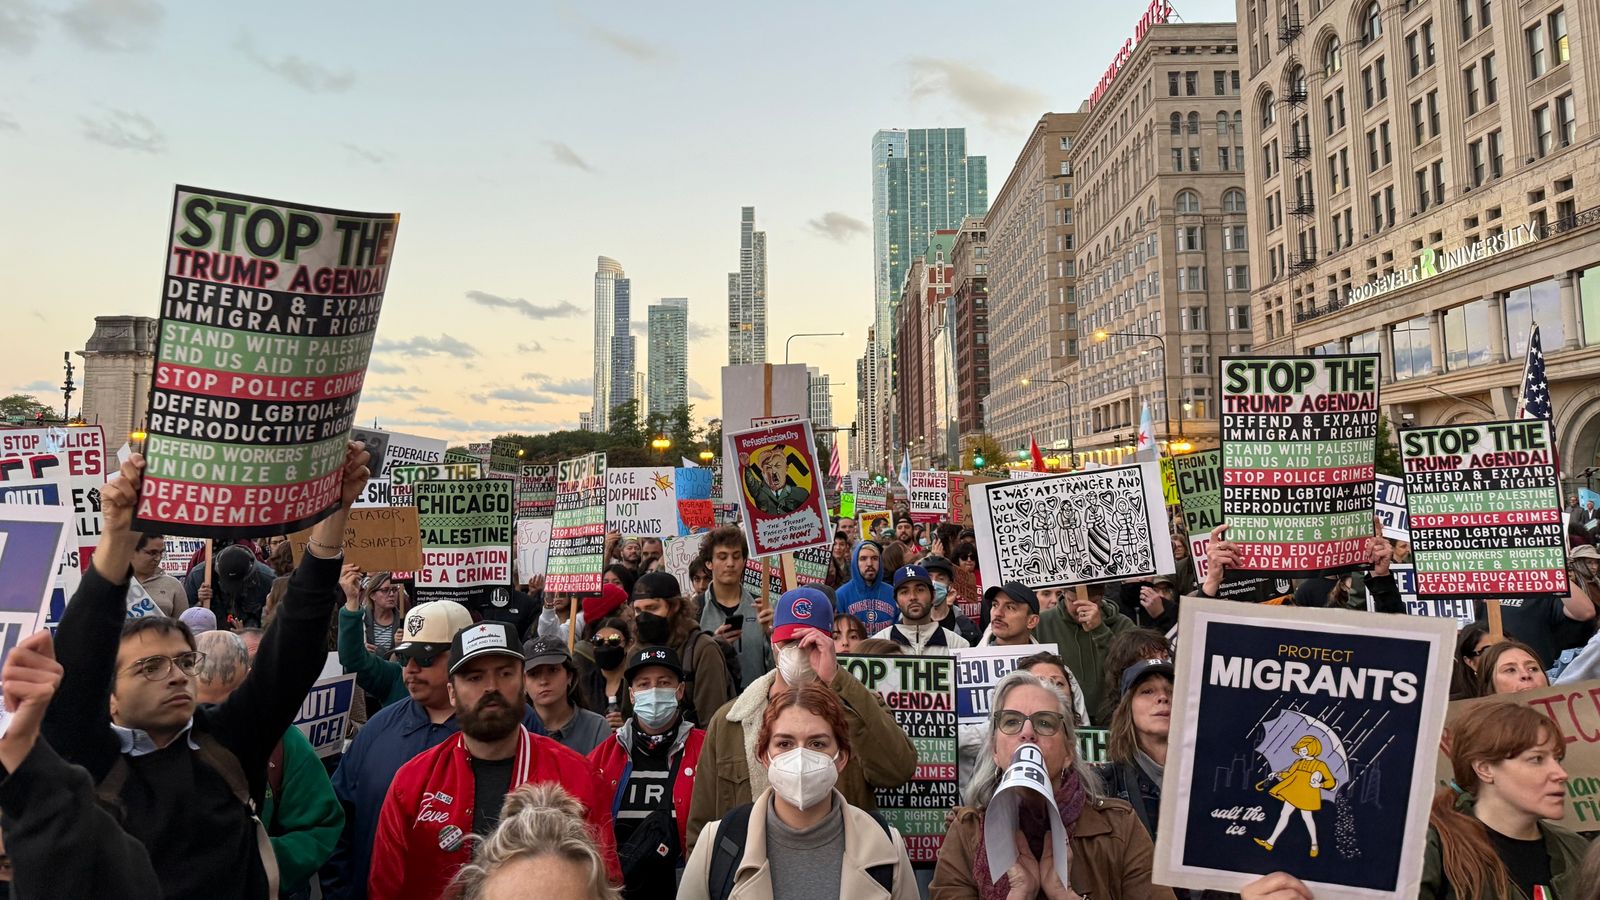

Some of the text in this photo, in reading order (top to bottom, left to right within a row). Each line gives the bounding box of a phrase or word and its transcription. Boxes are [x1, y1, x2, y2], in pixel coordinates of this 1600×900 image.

[177, 196, 394, 266] STOP THE
[1347, 265, 1419, 304] ROOSEVELT
[1439, 220, 1539, 270] UNIVERSITY
[174, 247, 385, 295] TRUMP AGENDA!
[168, 280, 382, 316] DEFEND & EXPAND
[165, 300, 378, 335] IMMIGRANT RIGHTS
[164, 324, 300, 355] STAND WITH
[162, 344, 326, 374] END US AID TO
[157, 367, 315, 397] STOP POLICE
[1225, 360, 1375, 394] STOP THE
[153, 391, 341, 422] DEFEND LGBTQIA+
[1224, 394, 1374, 413] TRUMP AGENDA!
[150, 414, 315, 441] REPRODUCTIVE
[1224, 413, 1377, 427] DEFEND & EXPAND
[1224, 426, 1377, 440] IMMIGRANT RIGHTS
[1405, 424, 1546, 456] STOP THE
[4, 434, 40, 450] STOP
[149, 436, 309, 463] DEFEND WORKERS'
[1226, 440, 1374, 455] STAND WITH PALESTINE
[386, 445, 440, 463] FEDERALES
[1226, 452, 1373, 467] END US AID TO ISRAEL
[1405, 450, 1548, 472] TRUMP AGENDA!
[147, 456, 298, 482] UNIONIZE &
[1224, 471, 1264, 483] STOP
[1274, 471, 1325, 483] POLICE
[1333, 467, 1373, 481] CRIMES
[1406, 467, 1554, 484] DEFEND & EXPAND
[609, 472, 635, 485] CAGE
[911, 479, 947, 488] CRIMES
[1407, 477, 1556, 493] IMMIGRANT RIGHTS
[143, 474, 336, 505] DEFEND EDUCATION
[417, 484, 446, 494] FROM
[608, 486, 657, 501] DOPHILES
[918, 492, 939, 501] FREE
[992, 477, 1140, 500] I WAS A STRANGER AND
[1224, 483, 1373, 500] DEFEND LGBTQIA+ AND
[1410, 489, 1555, 504] STAND WITH PALESTINE
[138, 499, 272, 523] ACADEMIC
[417, 494, 509, 515] CHICAGO
[616, 503, 640, 517] NOT
[992, 502, 1014, 513] YOU
[1225, 498, 1373, 513] REPRODUCTIVE RIGHTS
[1411, 499, 1555, 514] END US AID TO ISRAEL
[496, 516, 509, 525] TO
[606, 518, 662, 534] MIGRANTS
[994, 513, 1017, 524] WEL
[1226, 517, 1268, 528] DEFEND
[1274, 517, 1327, 528] WORKERS'
[1330, 514, 1360, 526] RIGHTS
[1363, 512, 1372, 522] TO
[1411, 512, 1558, 526] STOP POLICE CRIMES
[420, 527, 509, 545] PALESTINE
[789, 529, 811, 540] NOW!
[996, 525, 1020, 534] COM
[1226, 524, 1373, 541] UNIONIZE & STRIKE
[1412, 524, 1560, 539] DEFEND LGBTQIA+ AND
[360, 536, 413, 549] SHAPED?
[999, 535, 1016, 545] ED
[1413, 536, 1561, 550] REPRODUCTIVE RIGHTS
[1001, 546, 1019, 557] ME
[1290, 542, 1360, 555] EDUCATION
[1415, 549, 1562, 561] DEFEND WORKERS' RIGHTS TO
[1002, 558, 1022, 568] IN
[1417, 559, 1563, 571] UNIONIZE & STRIKE
[418, 567, 507, 583] IS A CRIME!
[1418, 573, 1466, 583] DEFEND
[1473, 572, 1548, 582] EDUCATION
[1555, 571, 1564, 580] &
[1419, 581, 1566, 593] ACADEMIC FREEDOM
[1278, 644, 1354, 663] PROTECT
[895, 660, 950, 691] THE
[1209, 654, 1418, 704] MIGRANTS
[895, 712, 956, 725] EXPAND
[309, 716, 344, 748] ICE!
[910, 795, 956, 807] RIGHTS
[413, 792, 450, 829] Steve
[1210, 804, 1266, 822] salt the
[1225, 822, 1247, 836] ice
